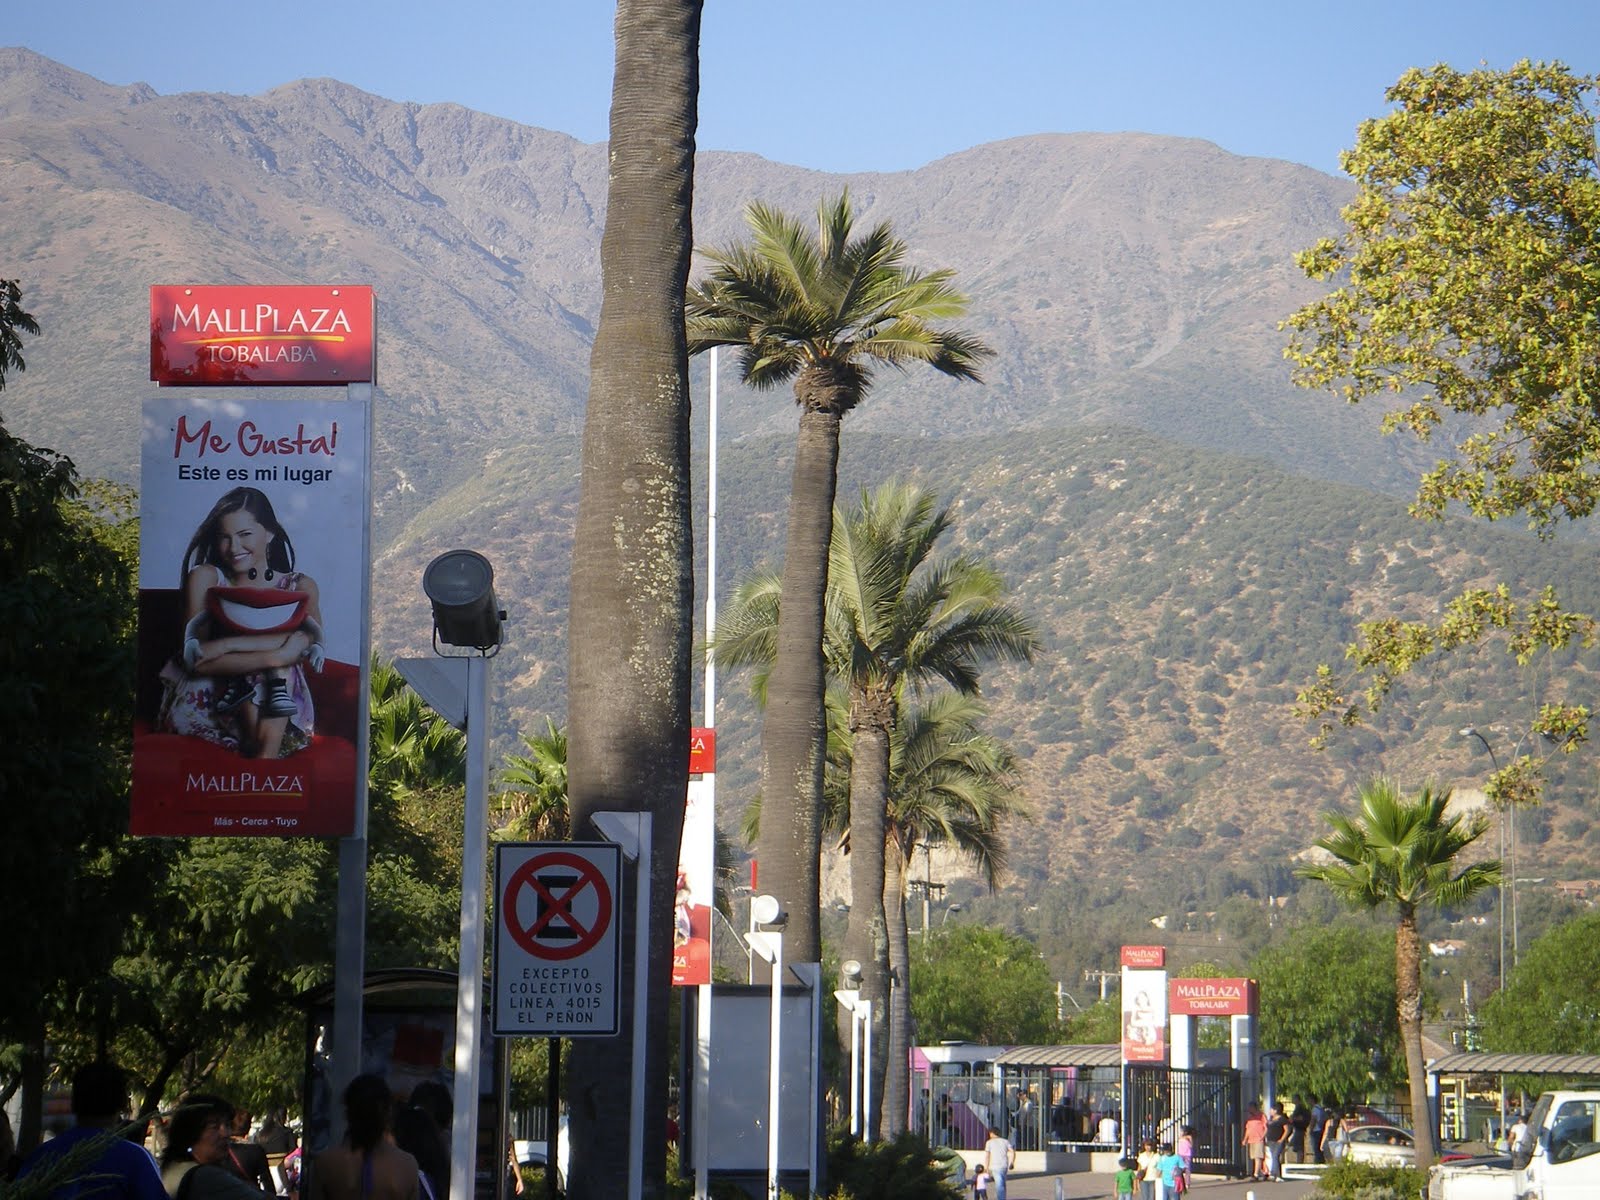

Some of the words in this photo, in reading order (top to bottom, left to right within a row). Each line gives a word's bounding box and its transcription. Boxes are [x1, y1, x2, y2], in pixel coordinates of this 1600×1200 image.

[172, 303, 352, 333] MALLPLAZA
[206, 345, 317, 363] TOBALABA
[174, 415, 231, 458] Me
[237, 421, 337, 457] Gusta!
[178, 465, 220, 481] Este
[226, 468, 249, 481] es
[254, 466, 277, 481] mi
[284, 466, 333, 485] lugar
[186, 772, 303, 792] MALLPLAZA
[214, 817, 233, 826] Más
[241, 817, 268, 826] Cerca
[276, 817, 298, 827] Tuyo
[523, 968, 589, 979] EXCEPTO
[510, 983, 602, 994] COLECTIVOS
[1177, 984, 1240, 997] MALLPLAZA
[566, 998, 601, 1009] 4015
[1189, 1001, 1229, 1009] TOBALABA
[518, 1012, 535, 1023] EL
